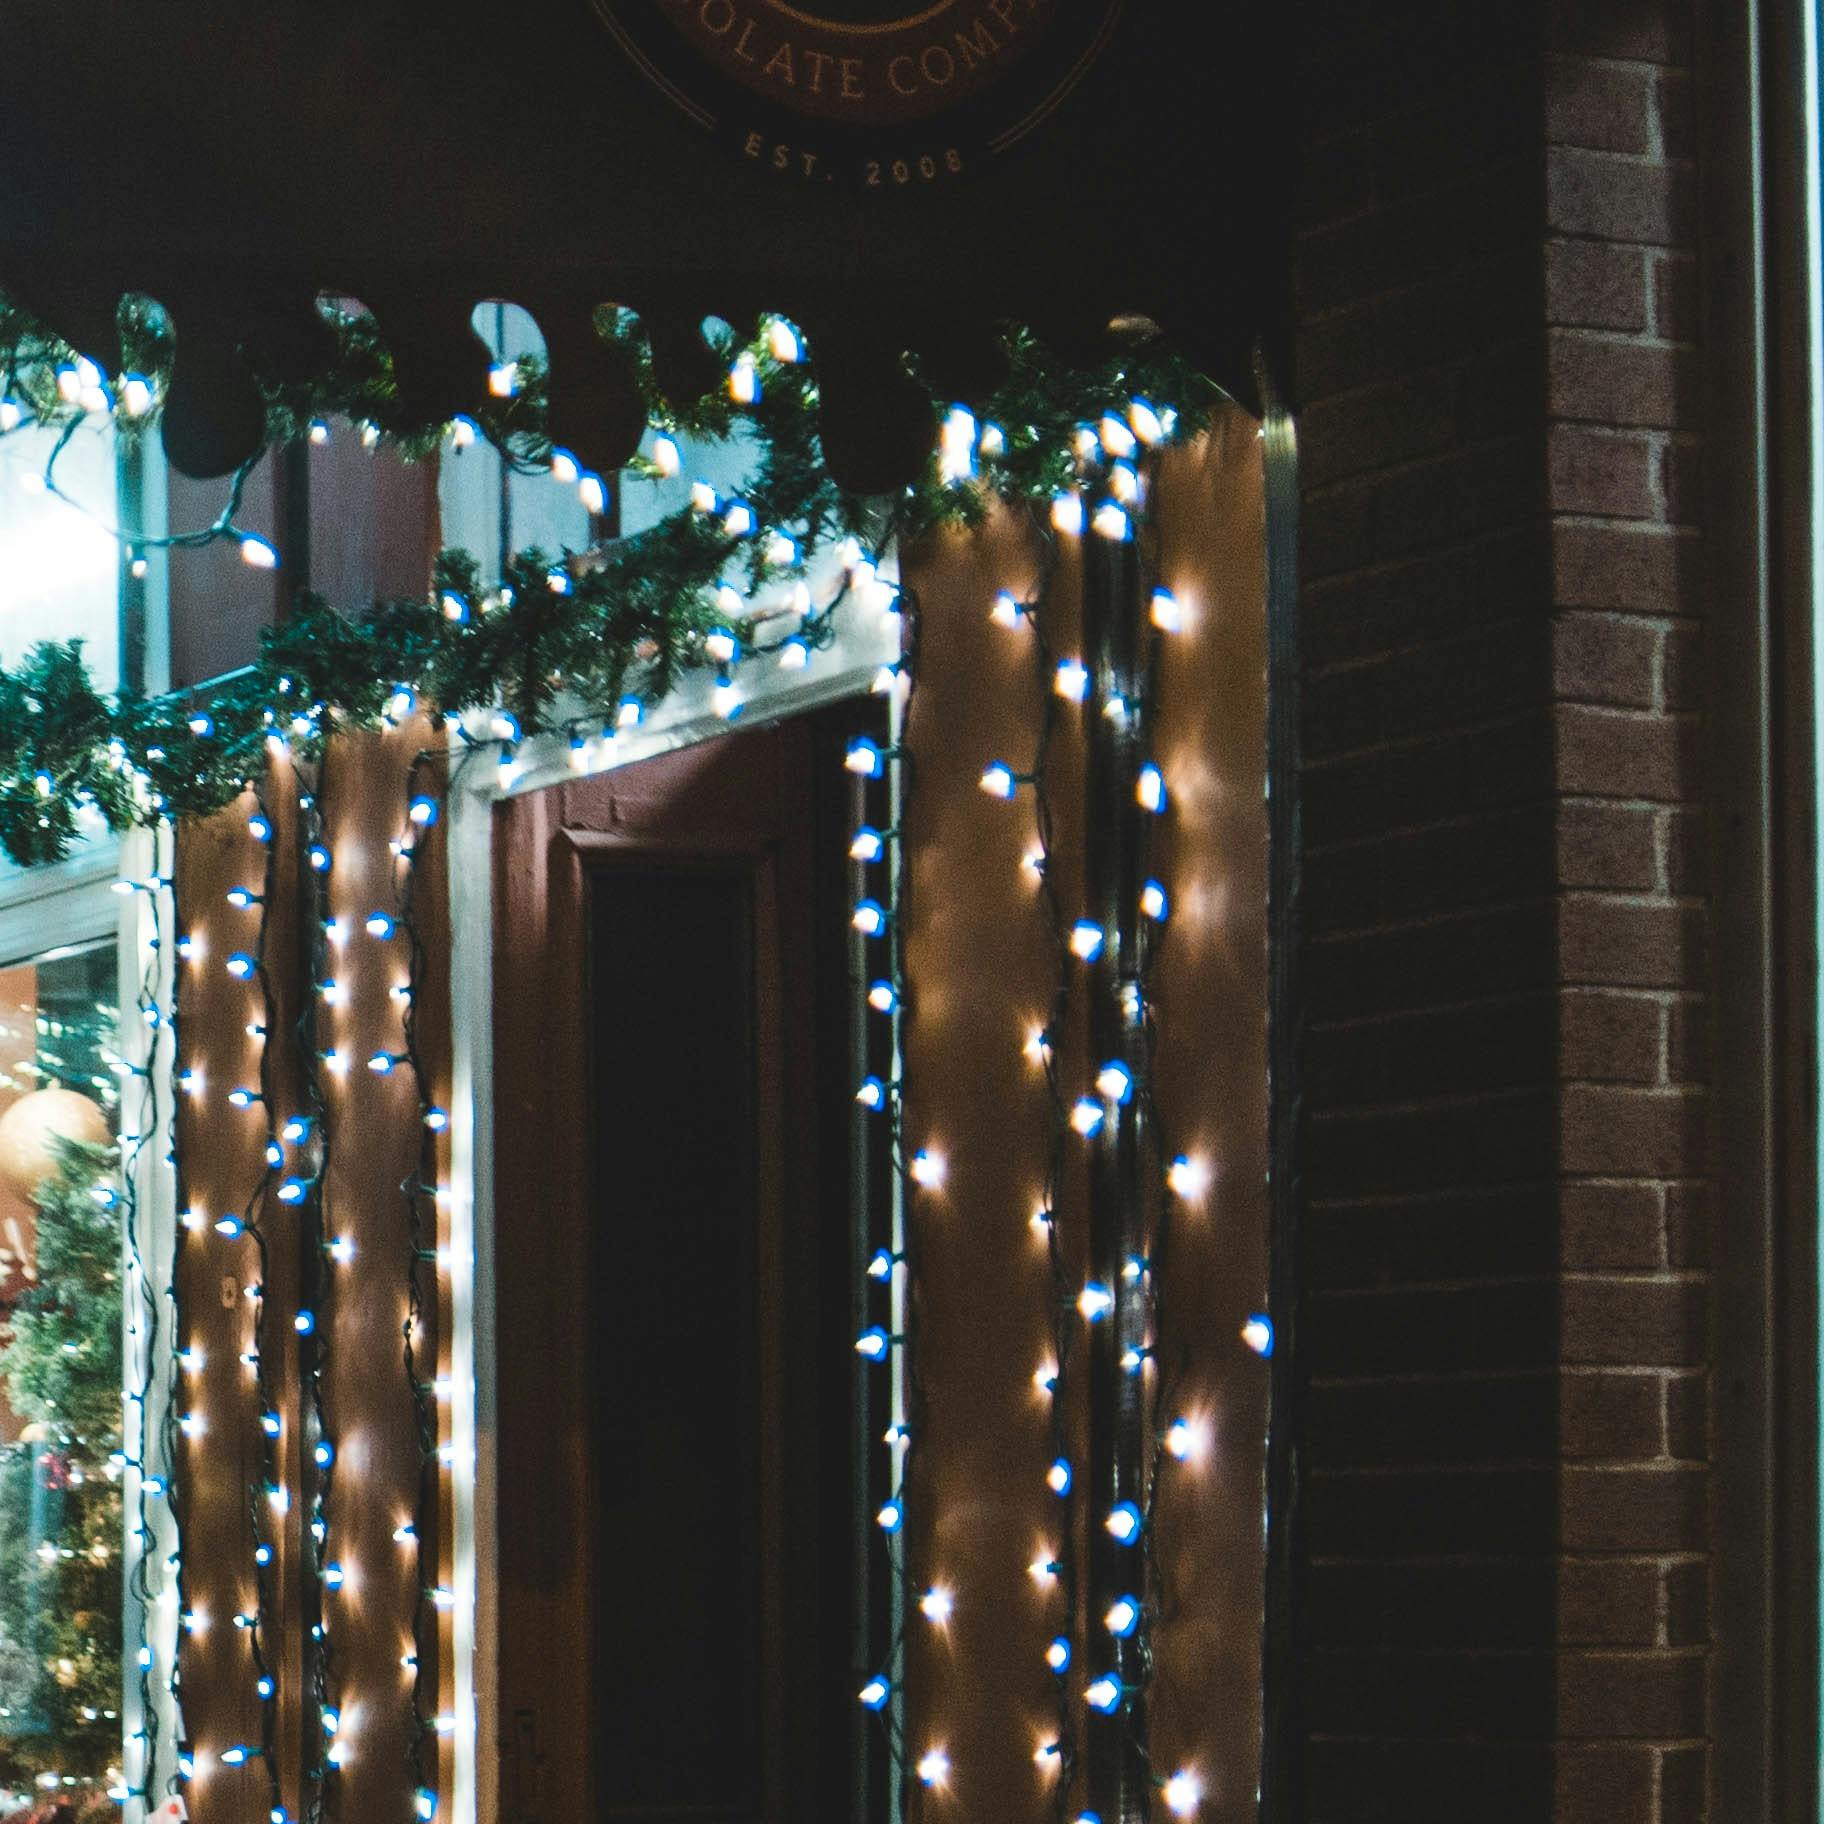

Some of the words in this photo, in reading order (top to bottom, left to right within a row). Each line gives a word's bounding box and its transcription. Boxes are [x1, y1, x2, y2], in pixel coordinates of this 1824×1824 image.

[888, 0, 1038, 95] COMP
[745, 132, 834, 183] EST.
[866, 148, 962, 185] 2008
